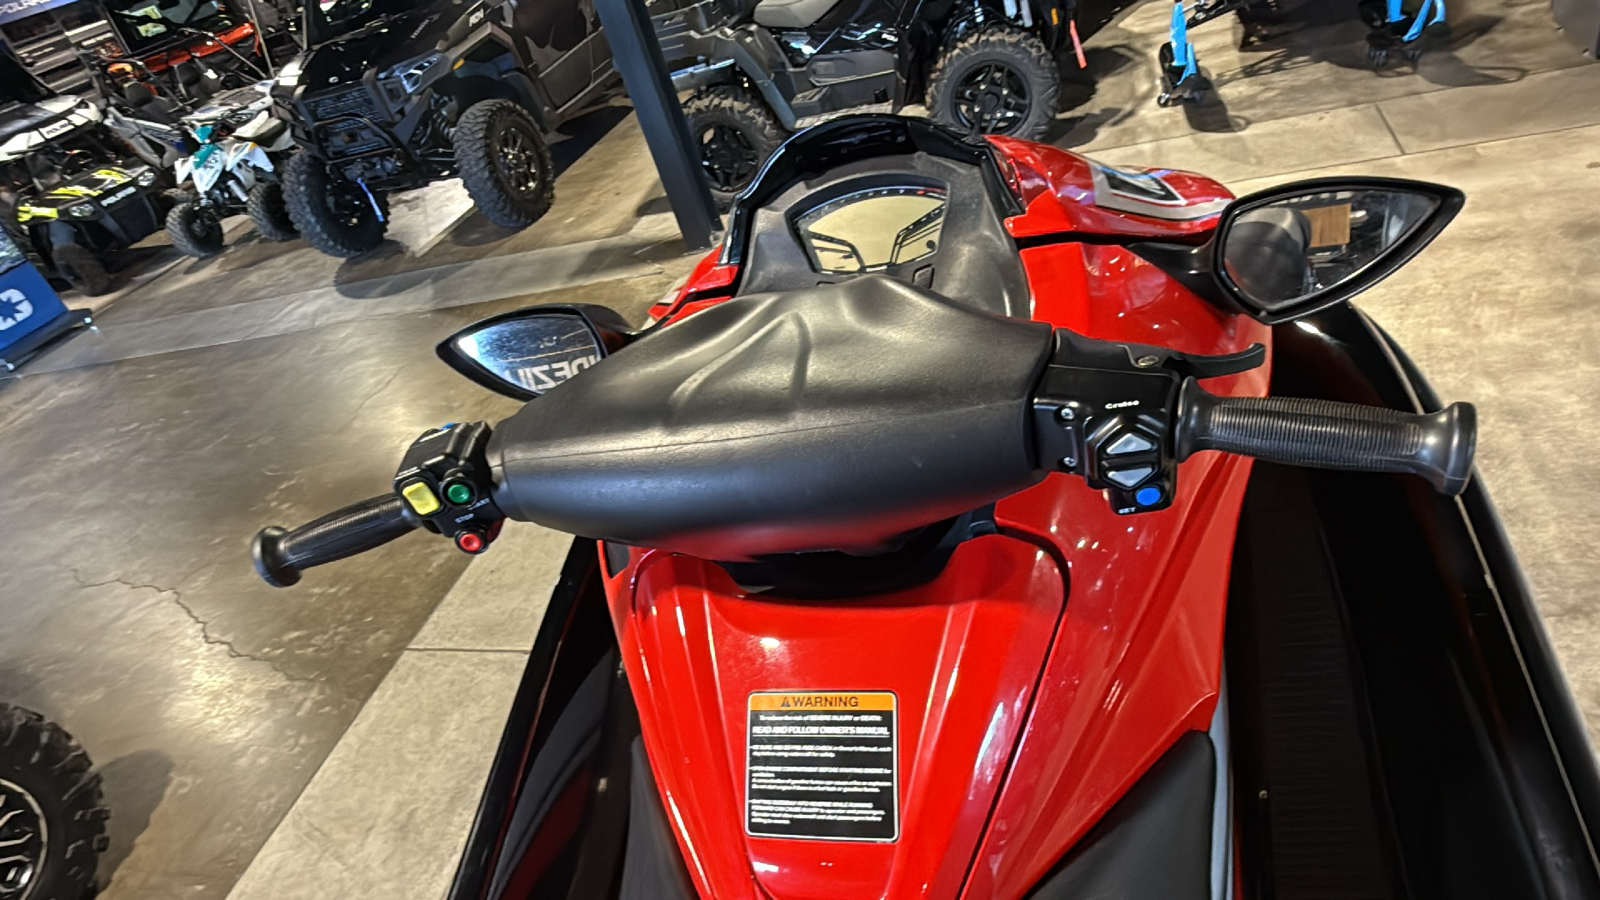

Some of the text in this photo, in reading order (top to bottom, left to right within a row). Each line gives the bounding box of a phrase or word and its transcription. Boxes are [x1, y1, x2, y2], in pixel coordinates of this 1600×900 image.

[1105, 400, 1140, 410] Cruise
[1118, 506, 1137, 515] SET
[454, 513, 475, 524] STOP
[792, 696, 859, 707] WARNING
[788, 726, 819, 734] FOLLOW
